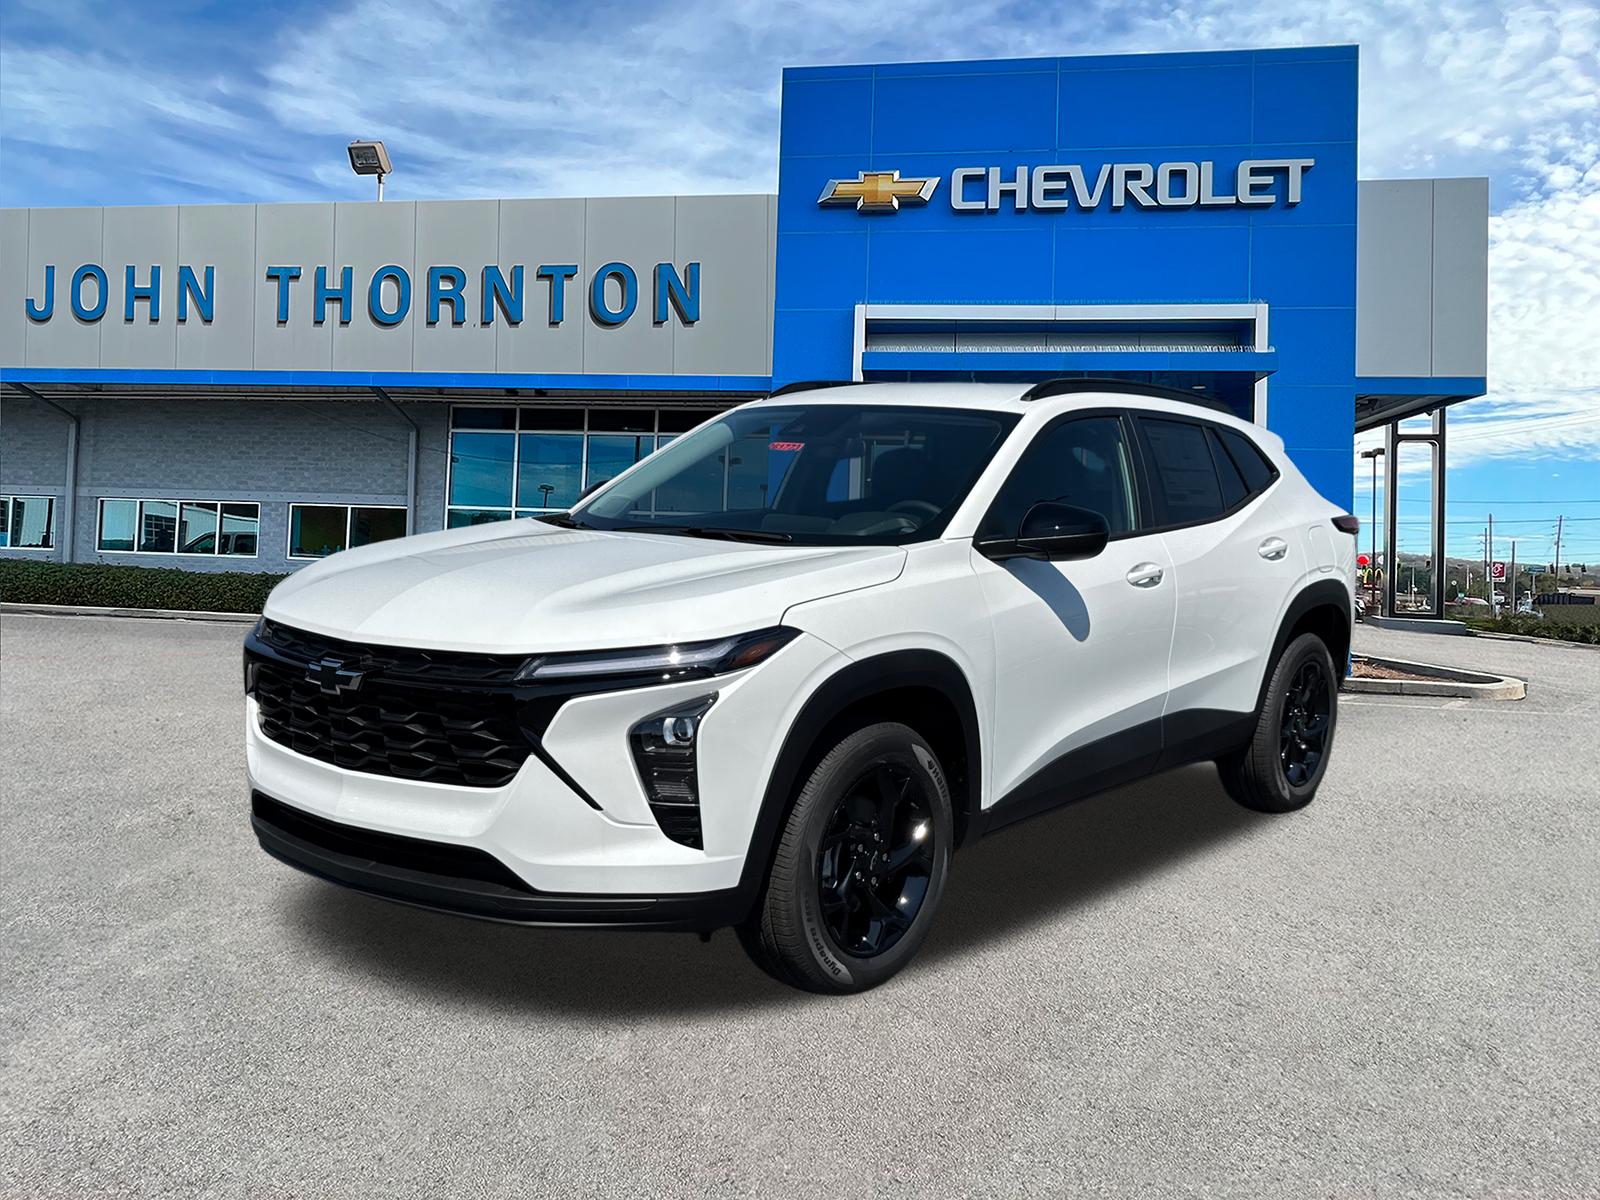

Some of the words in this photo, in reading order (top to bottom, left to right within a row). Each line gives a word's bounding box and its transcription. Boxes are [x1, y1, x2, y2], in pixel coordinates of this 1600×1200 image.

[951, 157, 1315, 211] CHEVROLET
[25, 263, 214, 323] JOHN
[265, 261, 702, 327] THORNTON
